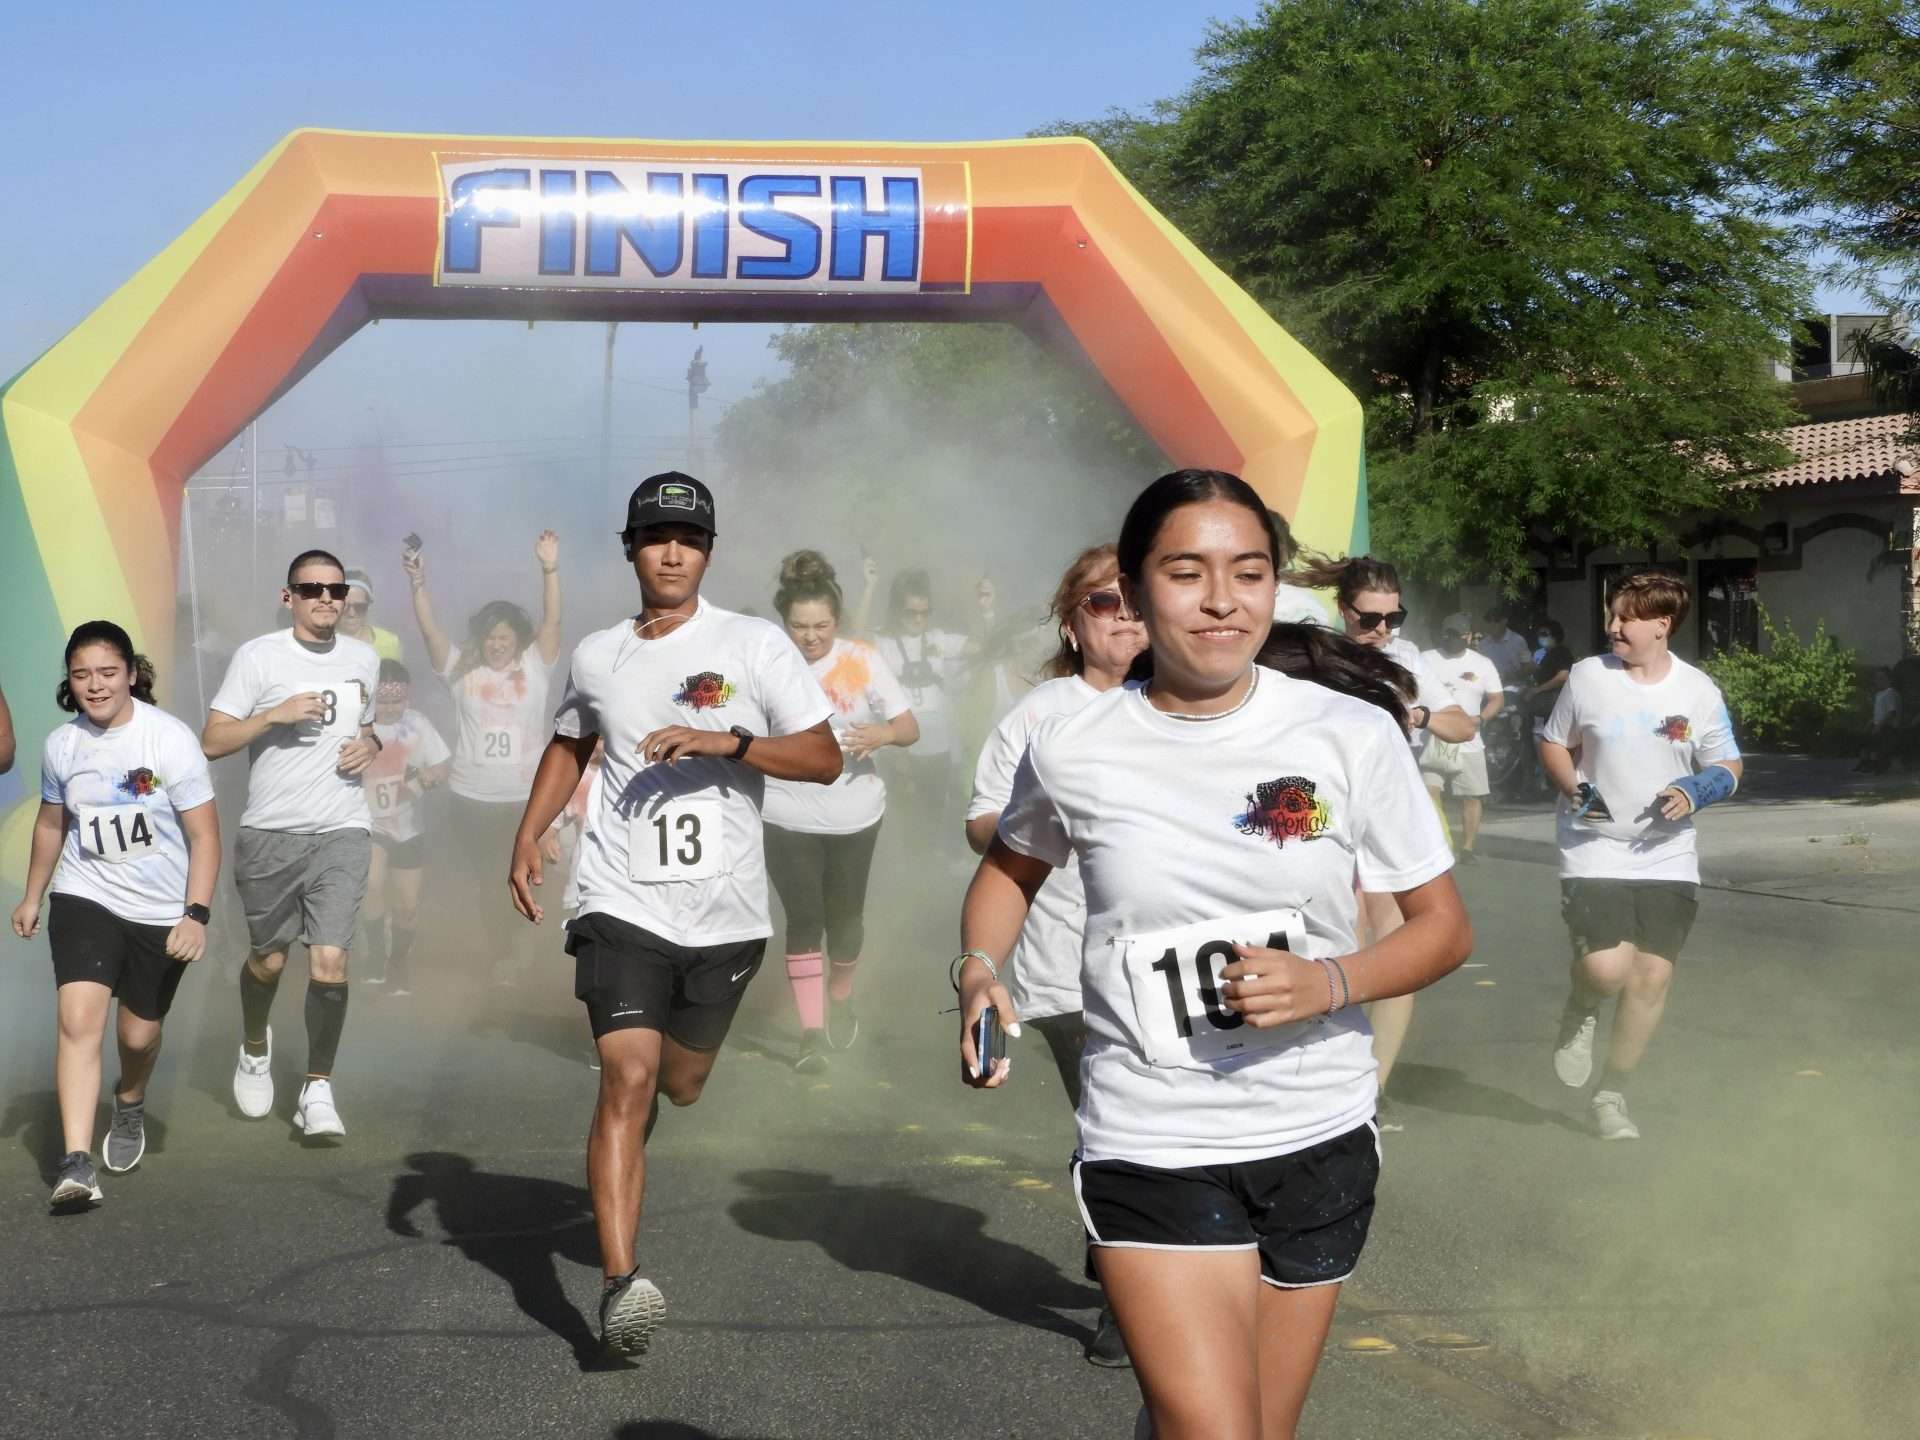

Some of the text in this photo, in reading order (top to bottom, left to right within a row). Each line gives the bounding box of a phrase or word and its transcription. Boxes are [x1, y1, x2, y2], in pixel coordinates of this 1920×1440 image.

[444, 168, 920, 281] FINISH
[485, 732, 511, 757] 29
[89, 812, 153, 855] 114
[652, 813, 702, 866] 13
[1152, 930, 1290, 1039] 10
